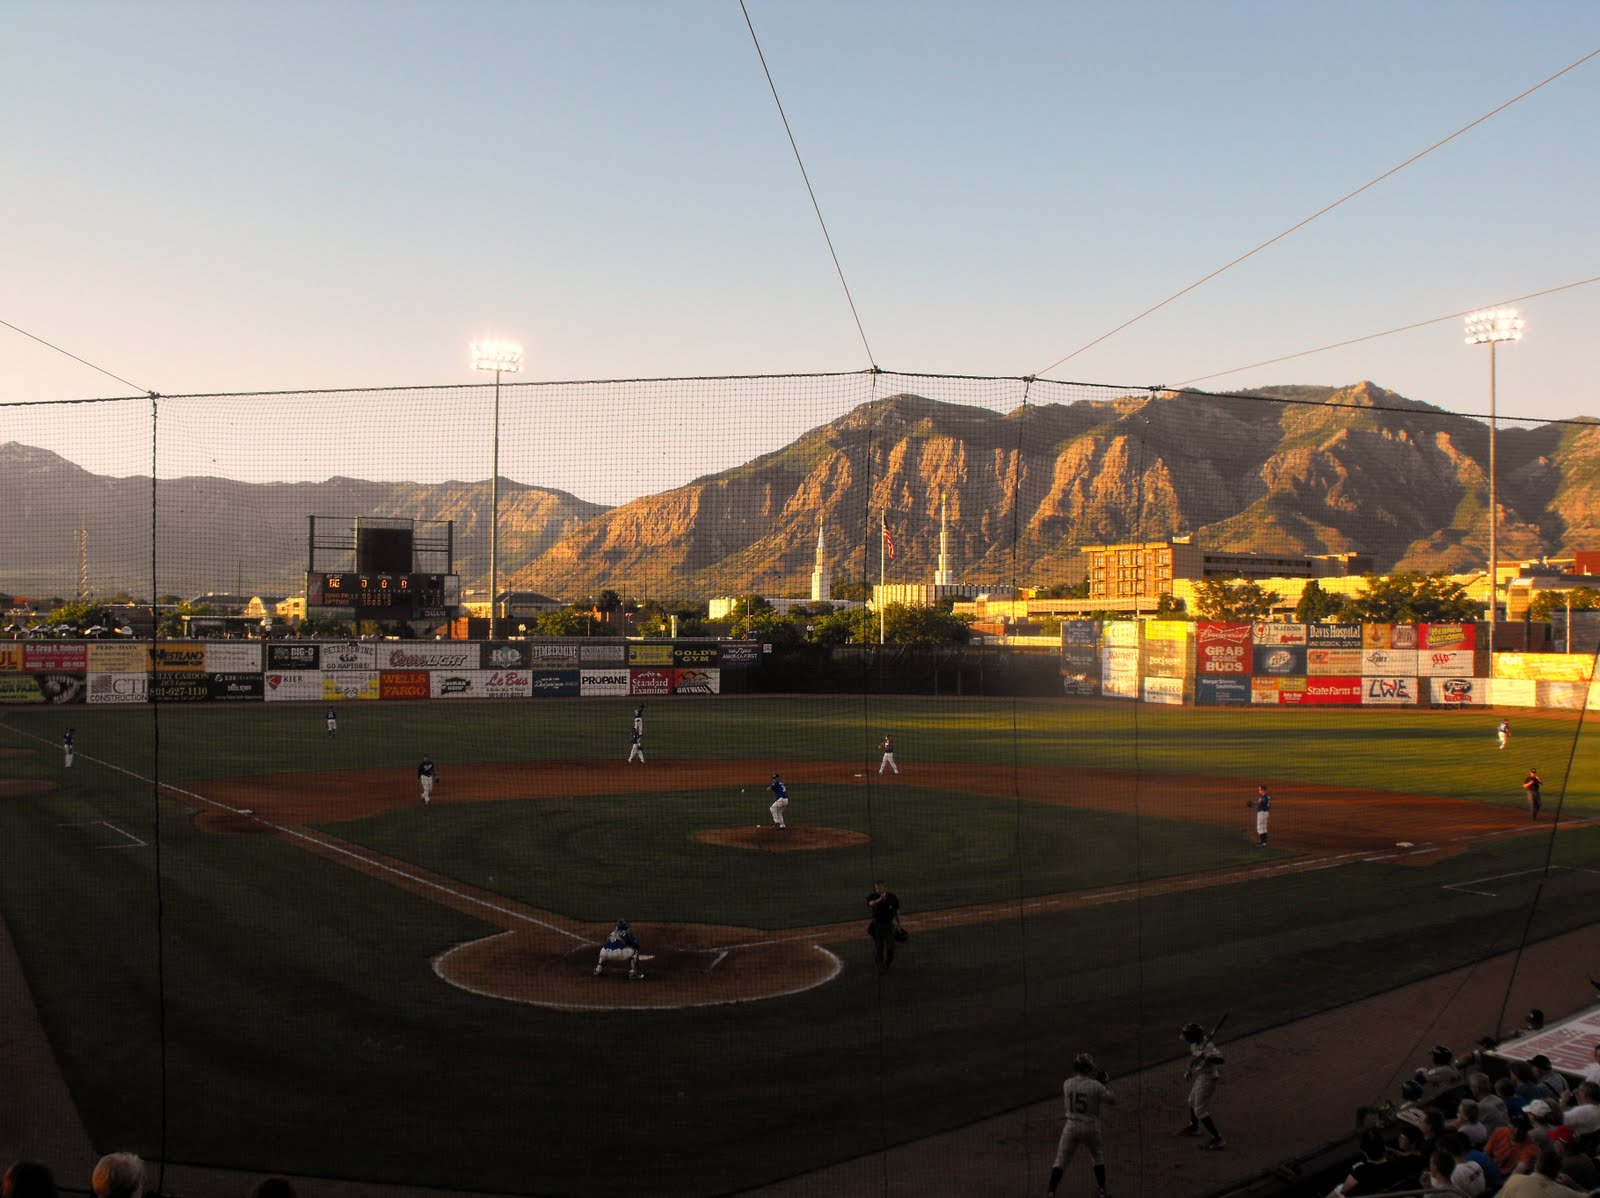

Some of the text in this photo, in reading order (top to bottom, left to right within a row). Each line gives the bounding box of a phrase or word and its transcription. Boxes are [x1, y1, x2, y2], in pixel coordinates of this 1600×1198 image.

[1205, 646, 1244, 656] GRAB
[1205, 662, 1243, 671] BUDS
[382, 674, 426, 683] WELLS
[582, 676, 627, 684] PROPANE
[632, 678, 668, 687] Standard
[113, 678, 146, 694] CTI
[633, 686, 669, 694] Examiner
[383, 686, 426, 696] FARGO
[1069, 1093, 1087, 1113] 15
